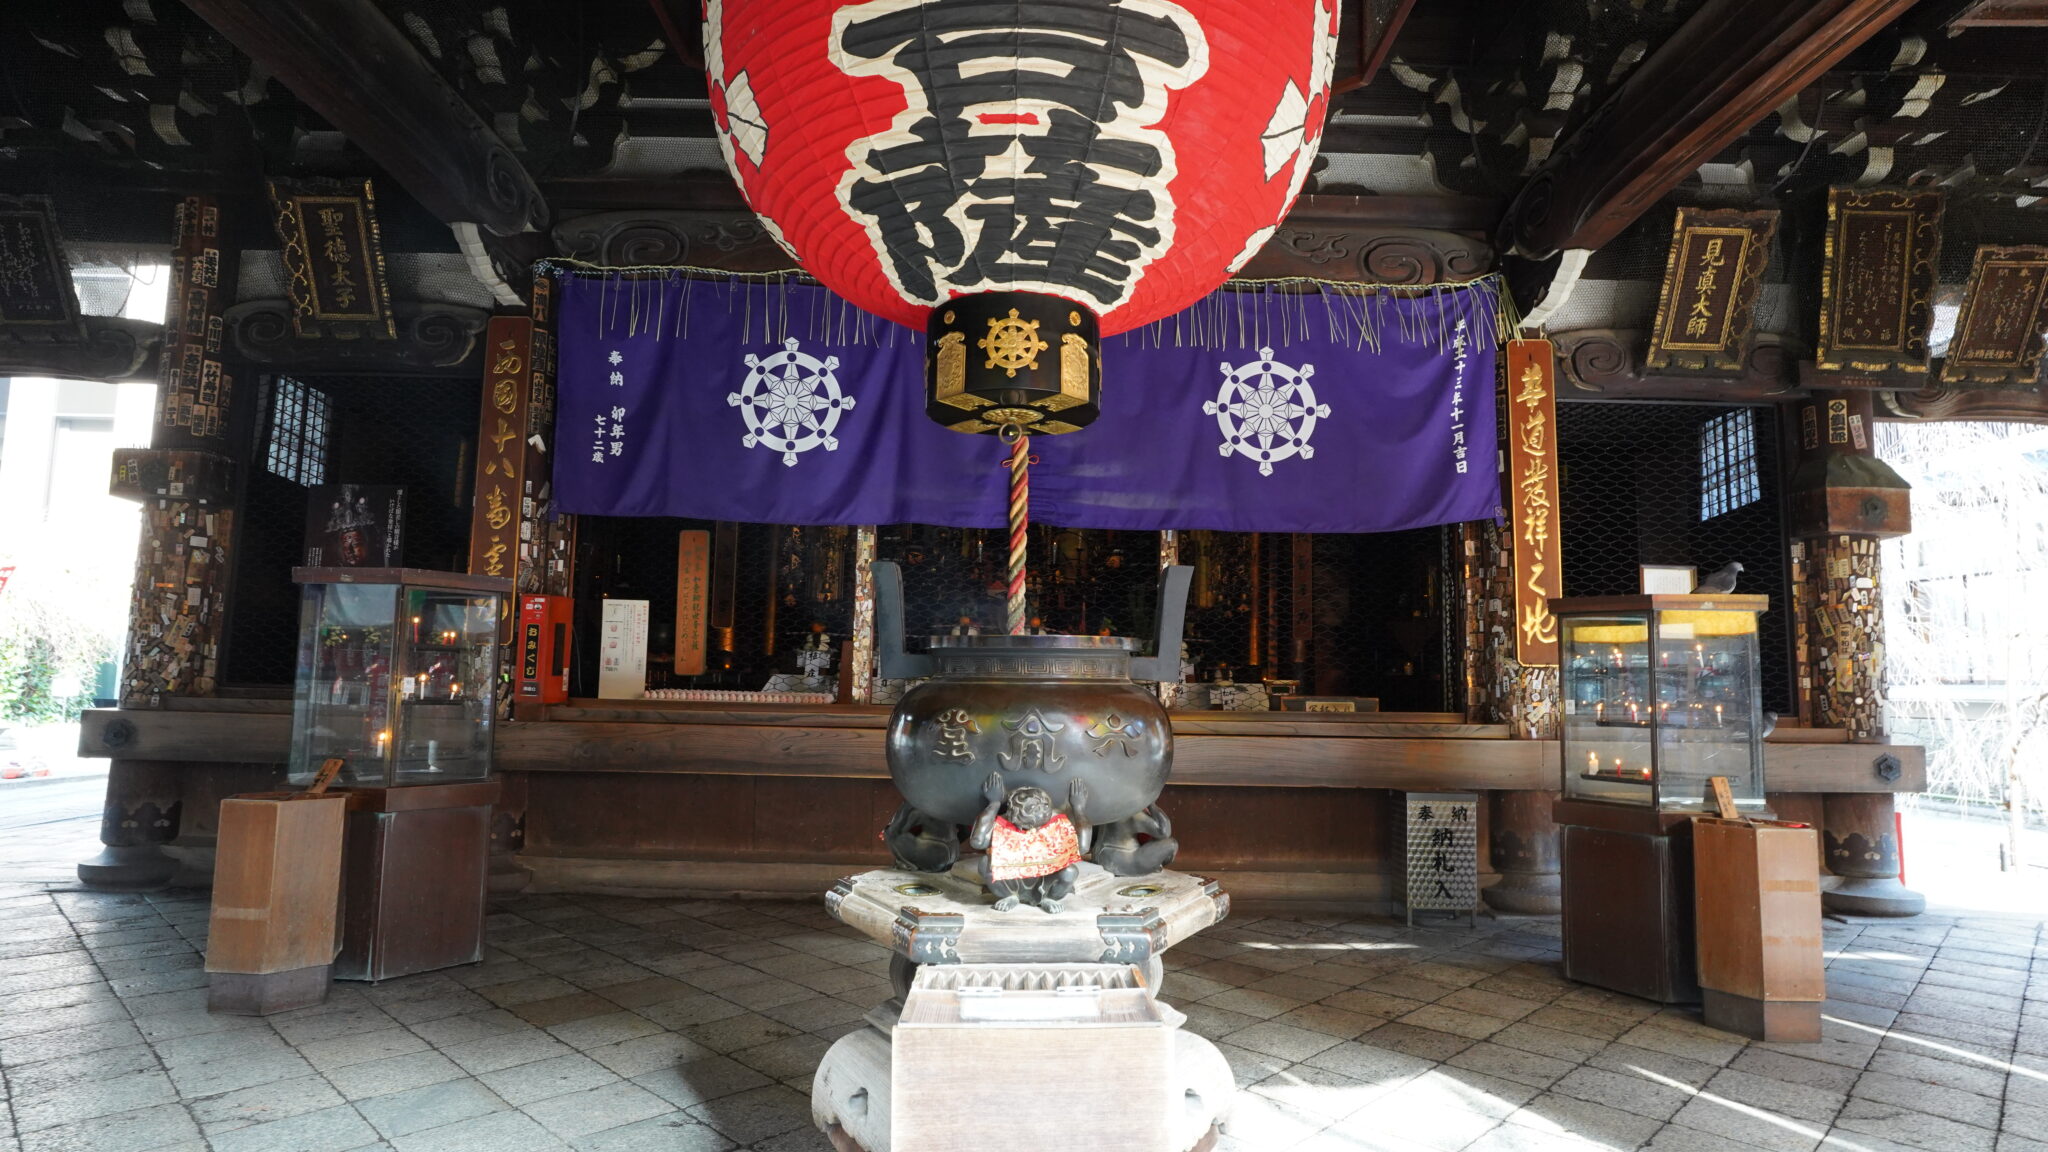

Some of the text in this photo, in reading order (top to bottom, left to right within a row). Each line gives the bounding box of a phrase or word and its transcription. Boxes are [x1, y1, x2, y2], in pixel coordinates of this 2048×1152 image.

[608, 350, 626, 457] 奉納 卯年男
[591, 414, 607, 464] 七十二歳
[526, 627, 538, 676] おみくじ
[1418, 804, 1468, 823] 奉納
[1432, 828, 1456, 900] 納札入
